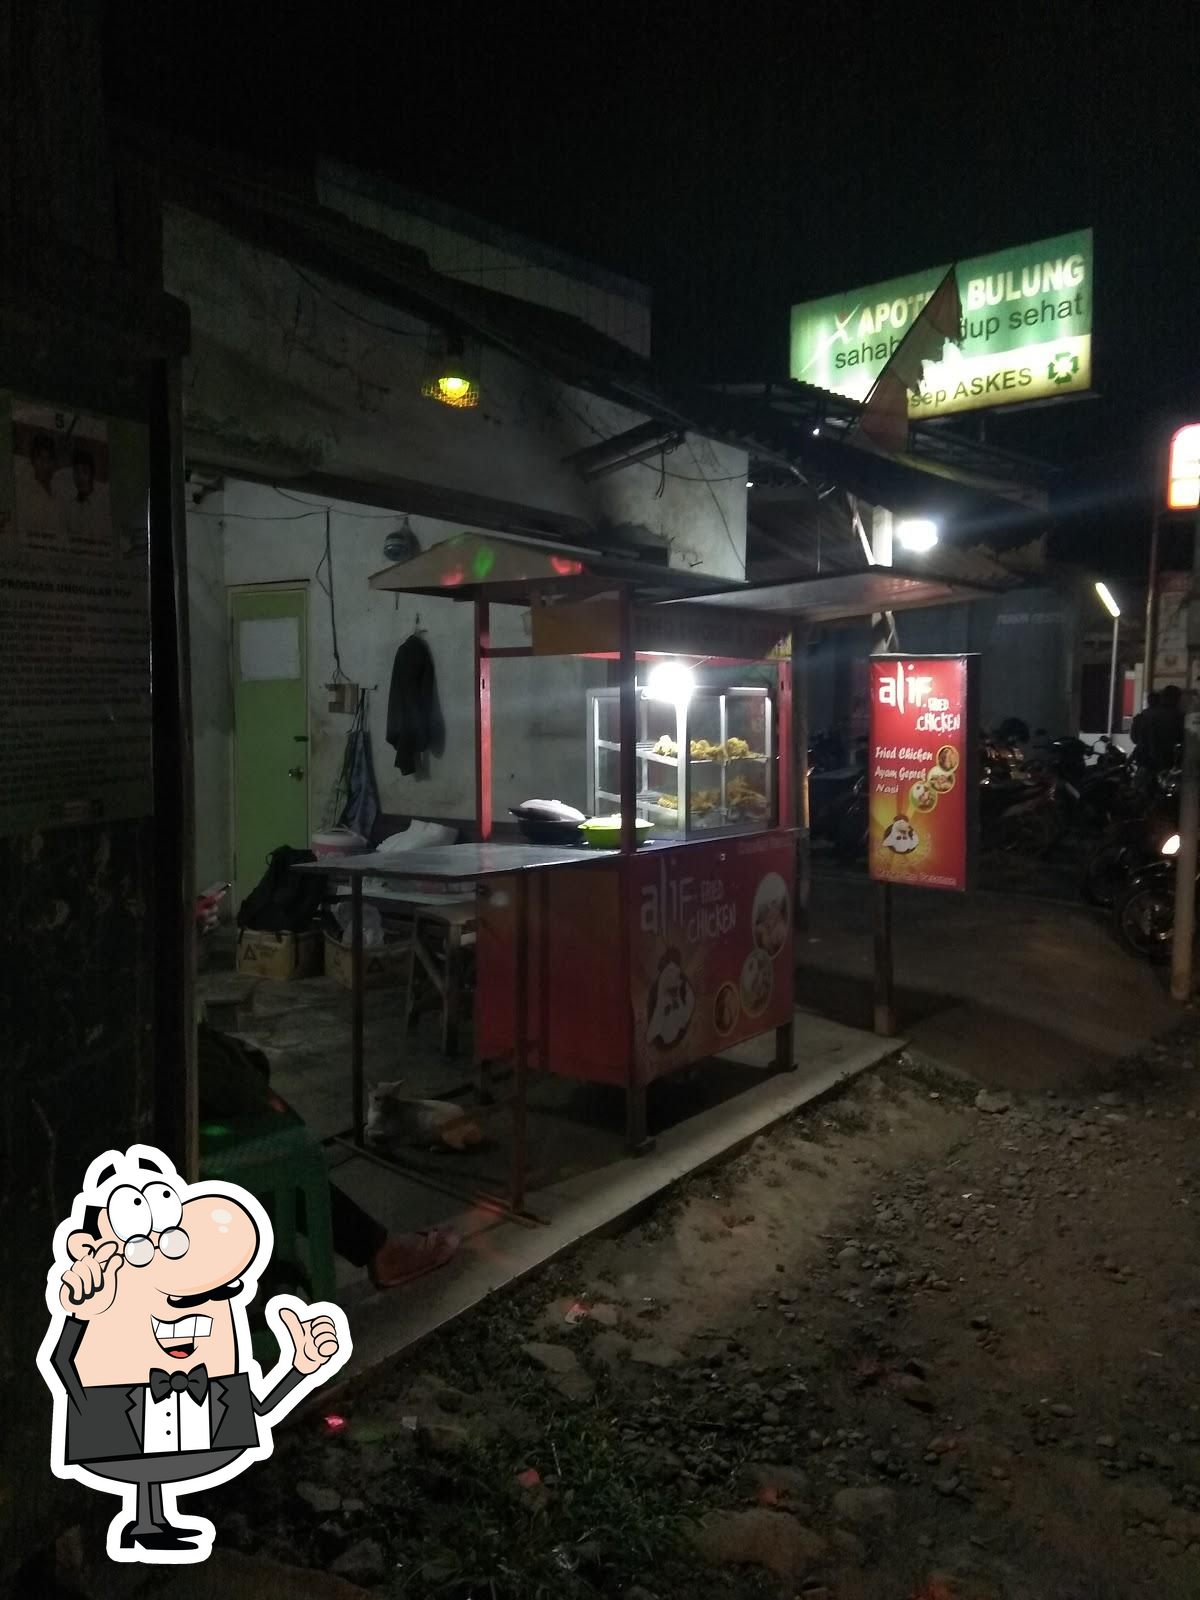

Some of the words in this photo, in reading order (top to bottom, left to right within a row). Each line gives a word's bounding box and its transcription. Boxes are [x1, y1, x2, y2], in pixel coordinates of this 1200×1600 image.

[966, 254, 1085, 312] BULUNG
[1008, 292, 1083, 330] sehat
[953, 367, 1032, 400] ASKES
[915, 711, 961, 733] CHICKEN
[874, 746, 897, 760] Fried
[898, 747, 934, 762] Chicken
[874, 766, 897, 779] Ayam
[875, 784, 899, 794] Nasi
